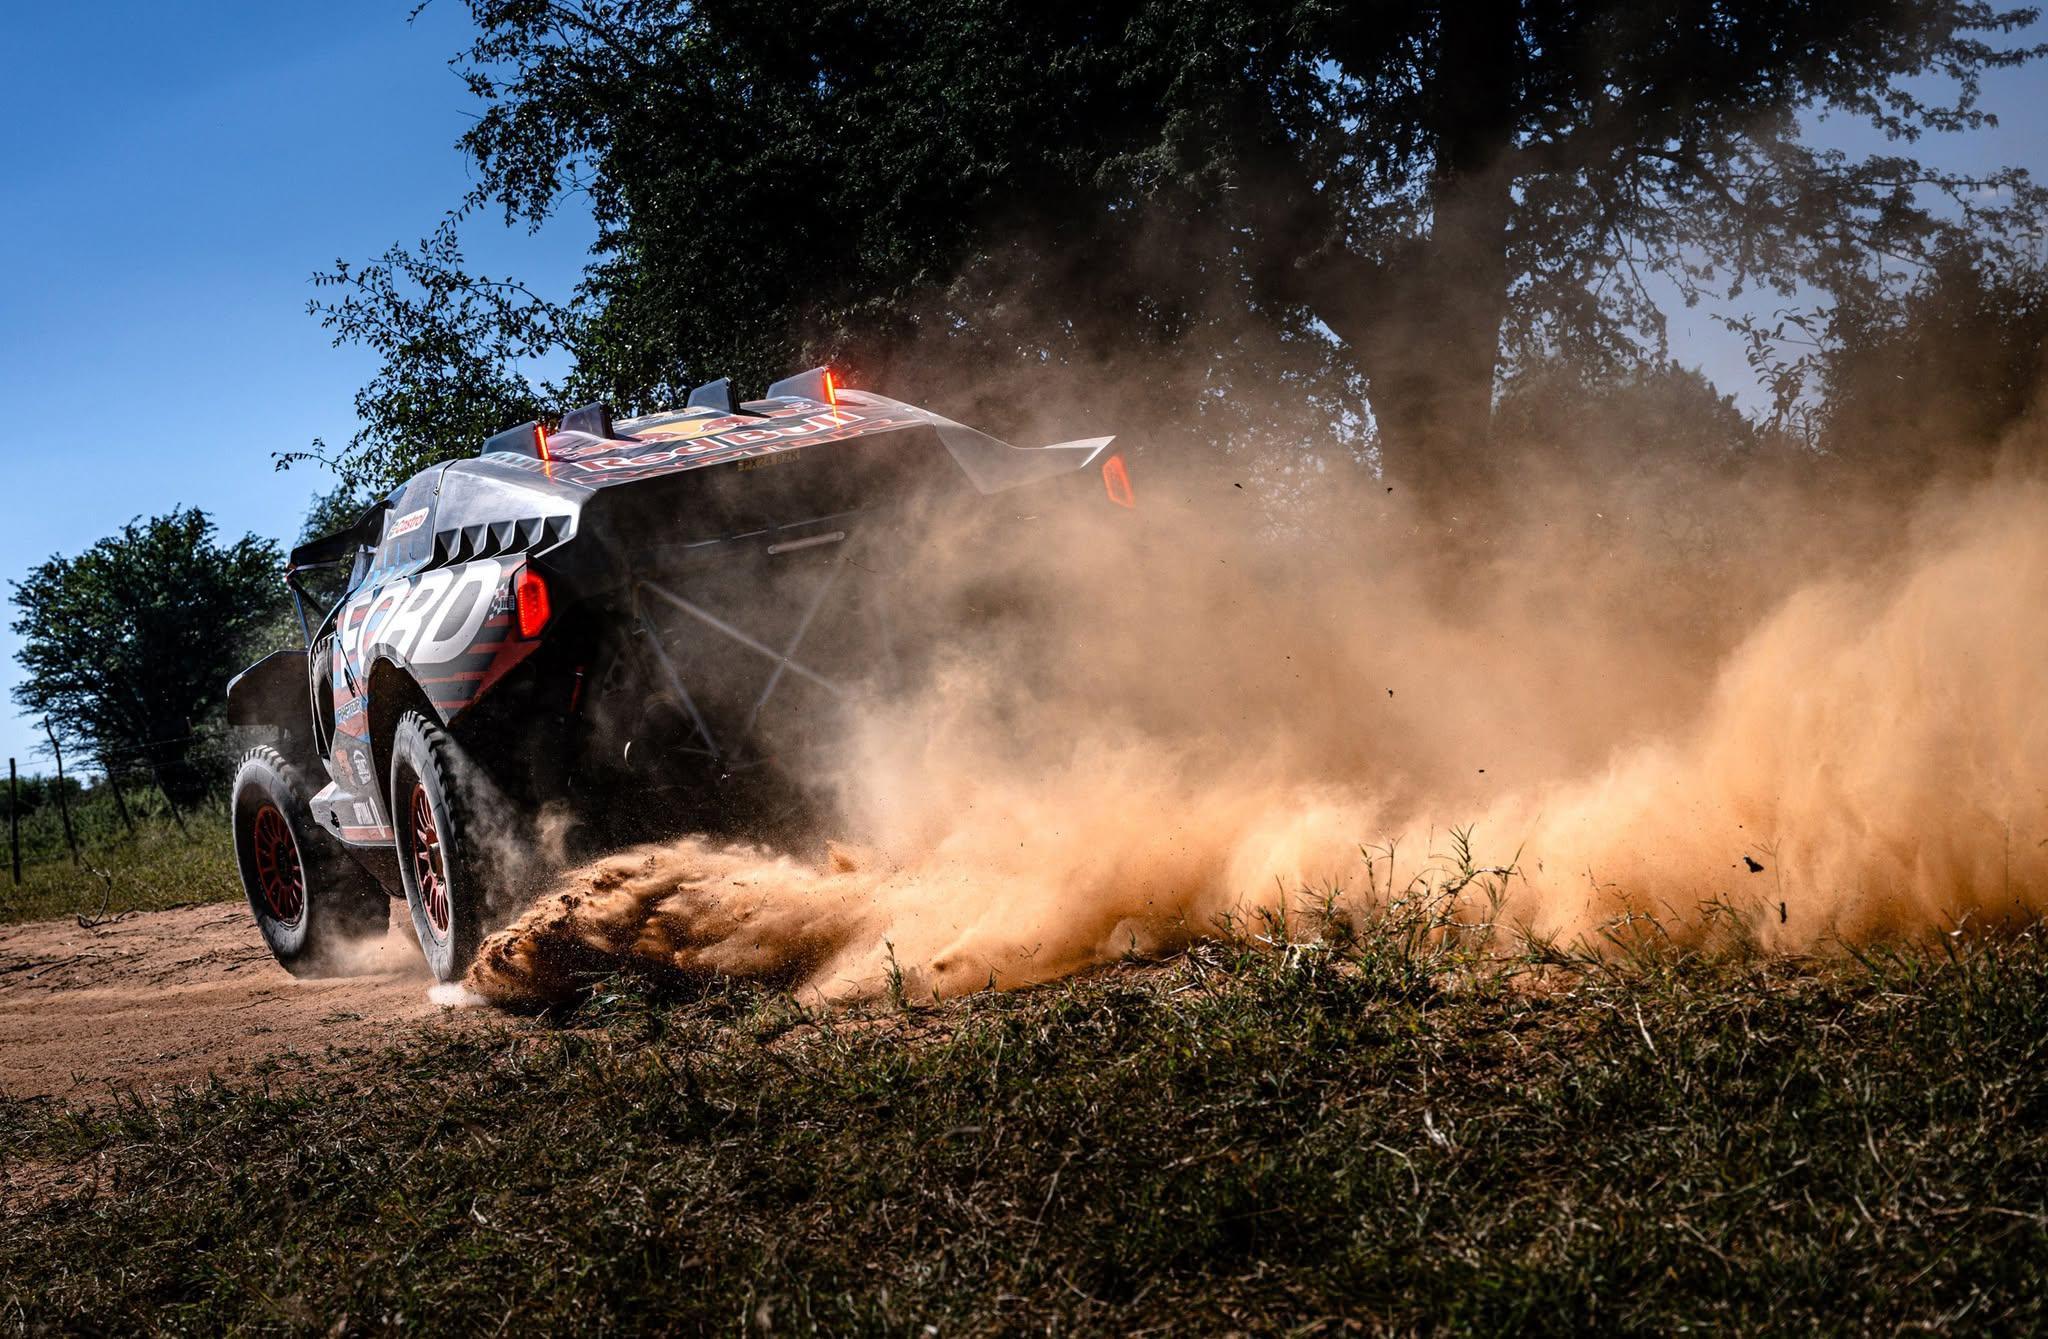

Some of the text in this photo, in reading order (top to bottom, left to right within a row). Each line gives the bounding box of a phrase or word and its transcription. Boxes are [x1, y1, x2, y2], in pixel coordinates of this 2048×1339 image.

[569, 410, 867, 473] Red Bull
[340, 558, 502, 689] FORD
